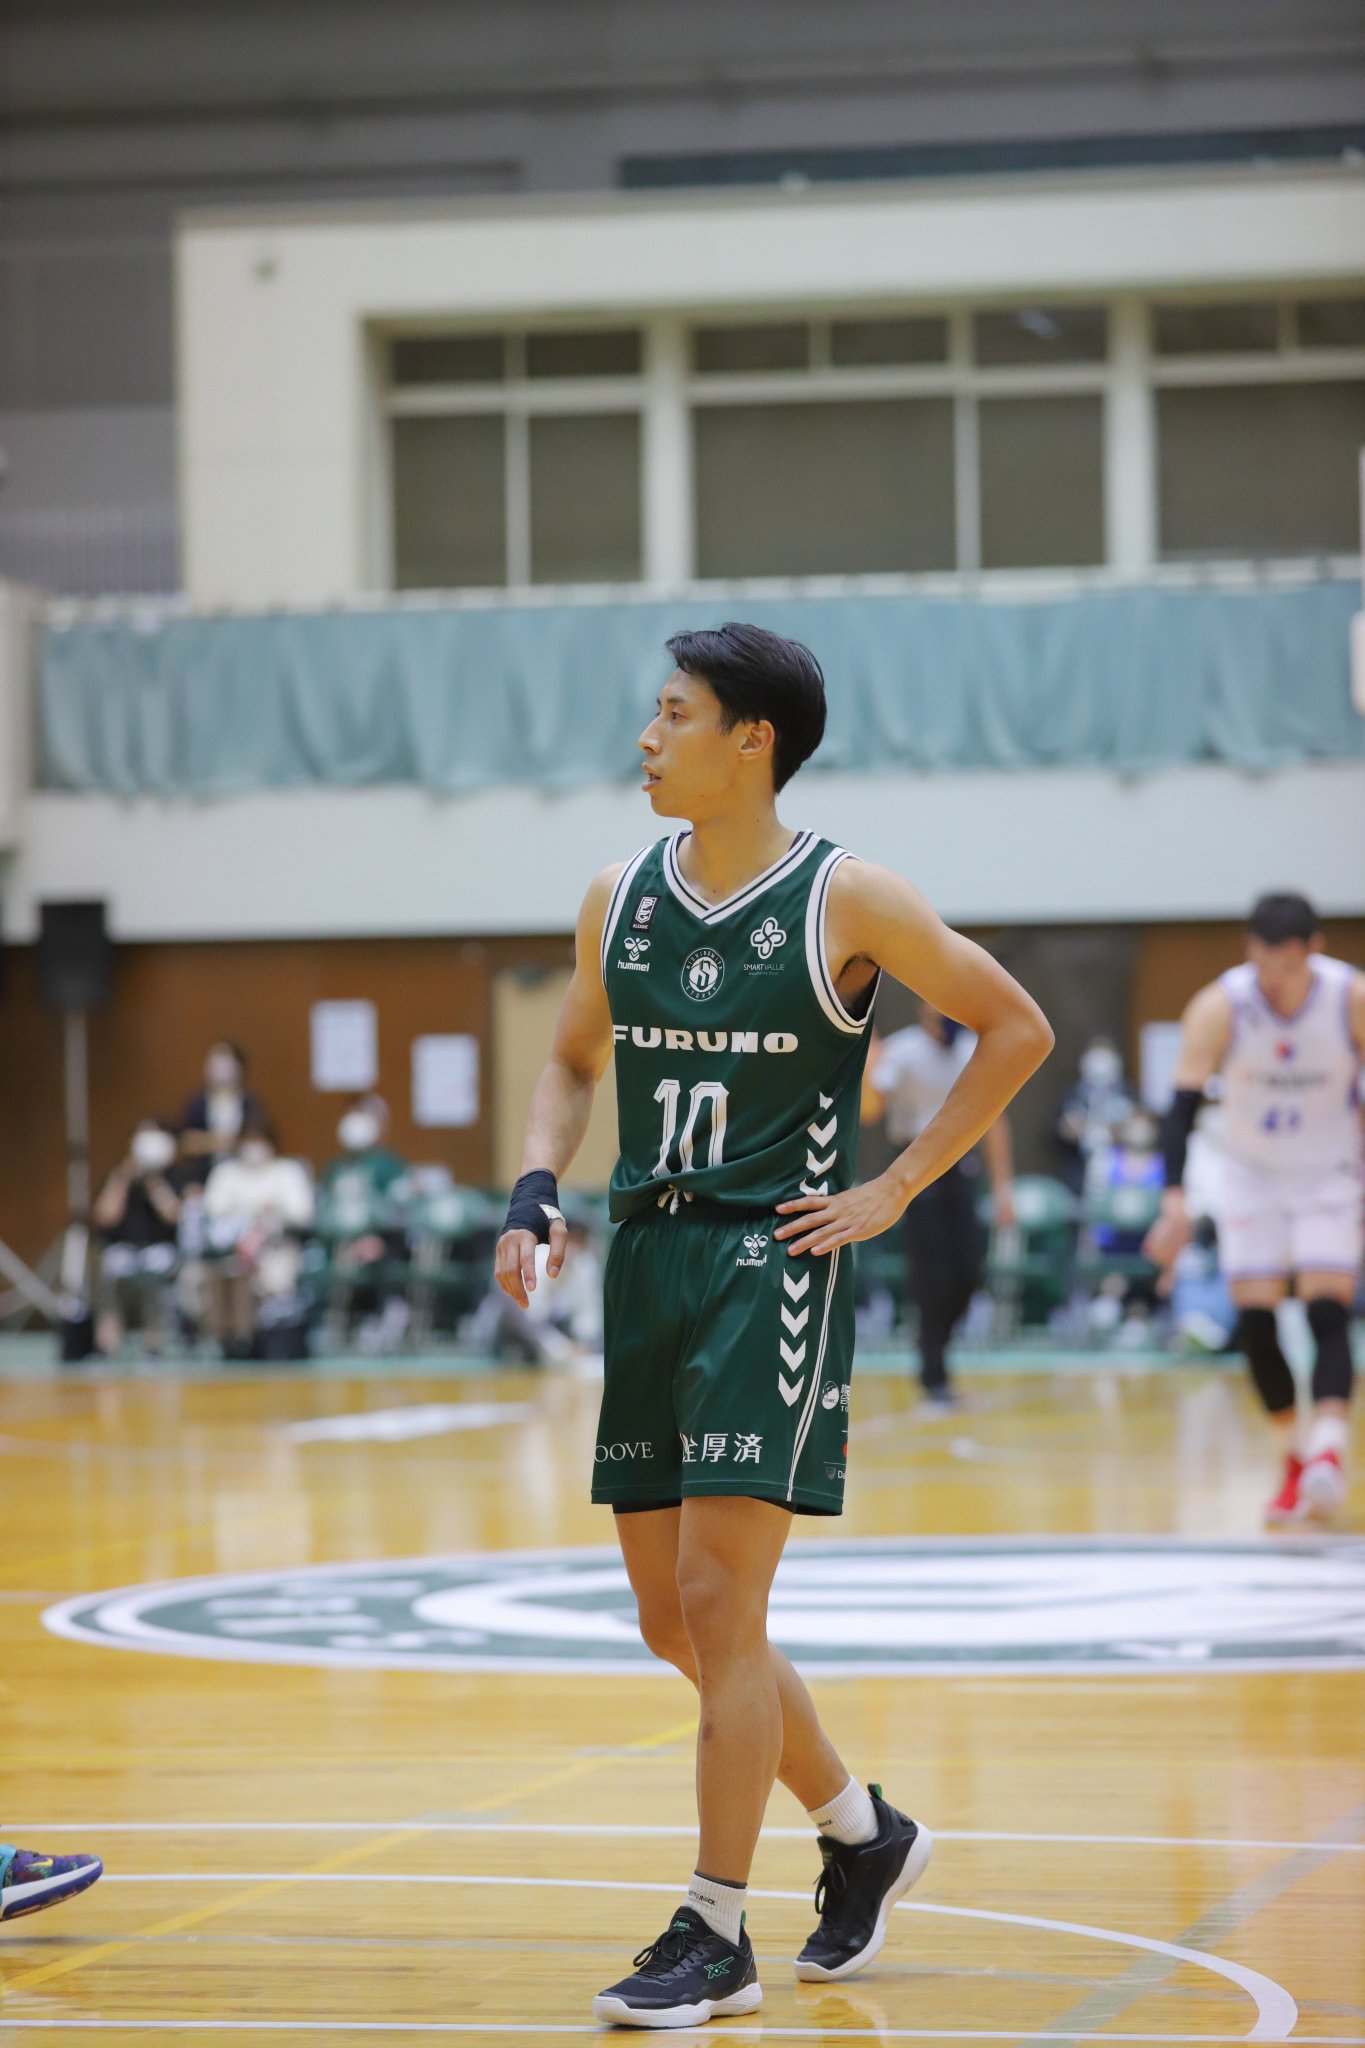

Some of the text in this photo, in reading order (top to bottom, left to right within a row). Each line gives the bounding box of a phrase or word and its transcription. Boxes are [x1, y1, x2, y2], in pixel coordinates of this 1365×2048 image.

[617, 959, 650, 972] hummel
[612, 1024, 799, 1053] FURUNO
[652, 1078, 730, 1179] 10
[736, 1253, 768, 1267] humml
